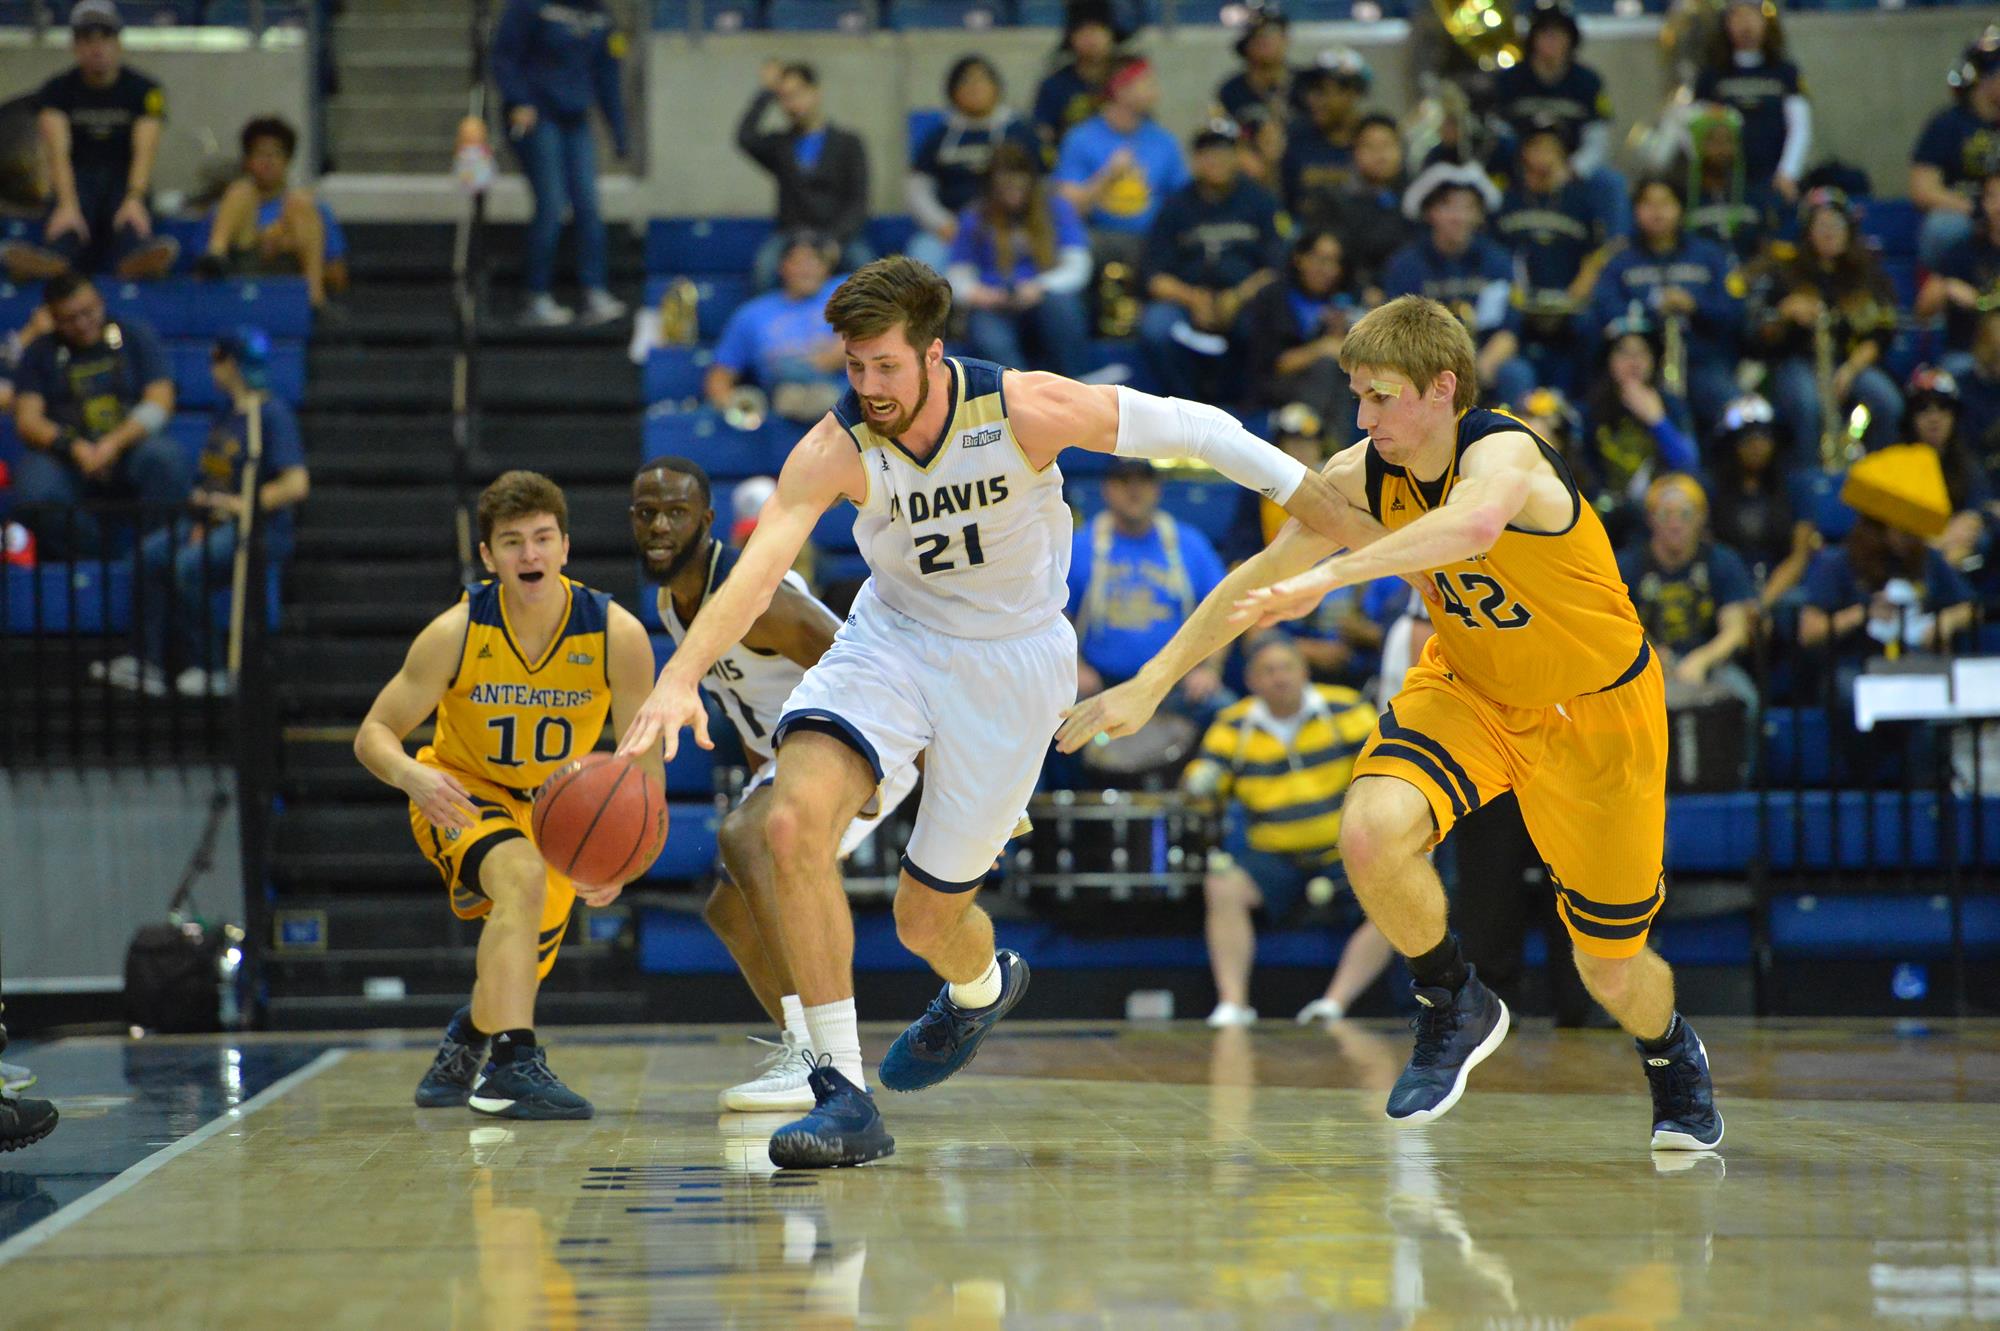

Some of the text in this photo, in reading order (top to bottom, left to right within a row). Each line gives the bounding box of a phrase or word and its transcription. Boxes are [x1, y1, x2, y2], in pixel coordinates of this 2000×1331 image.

[909, 475, 1009, 524] DAVIS
[914, 523, 984, 575] 21
[1433, 571, 1532, 629] 42
[470, 684, 592, 708] ANTEATERS
[487, 716, 573, 767] 10
